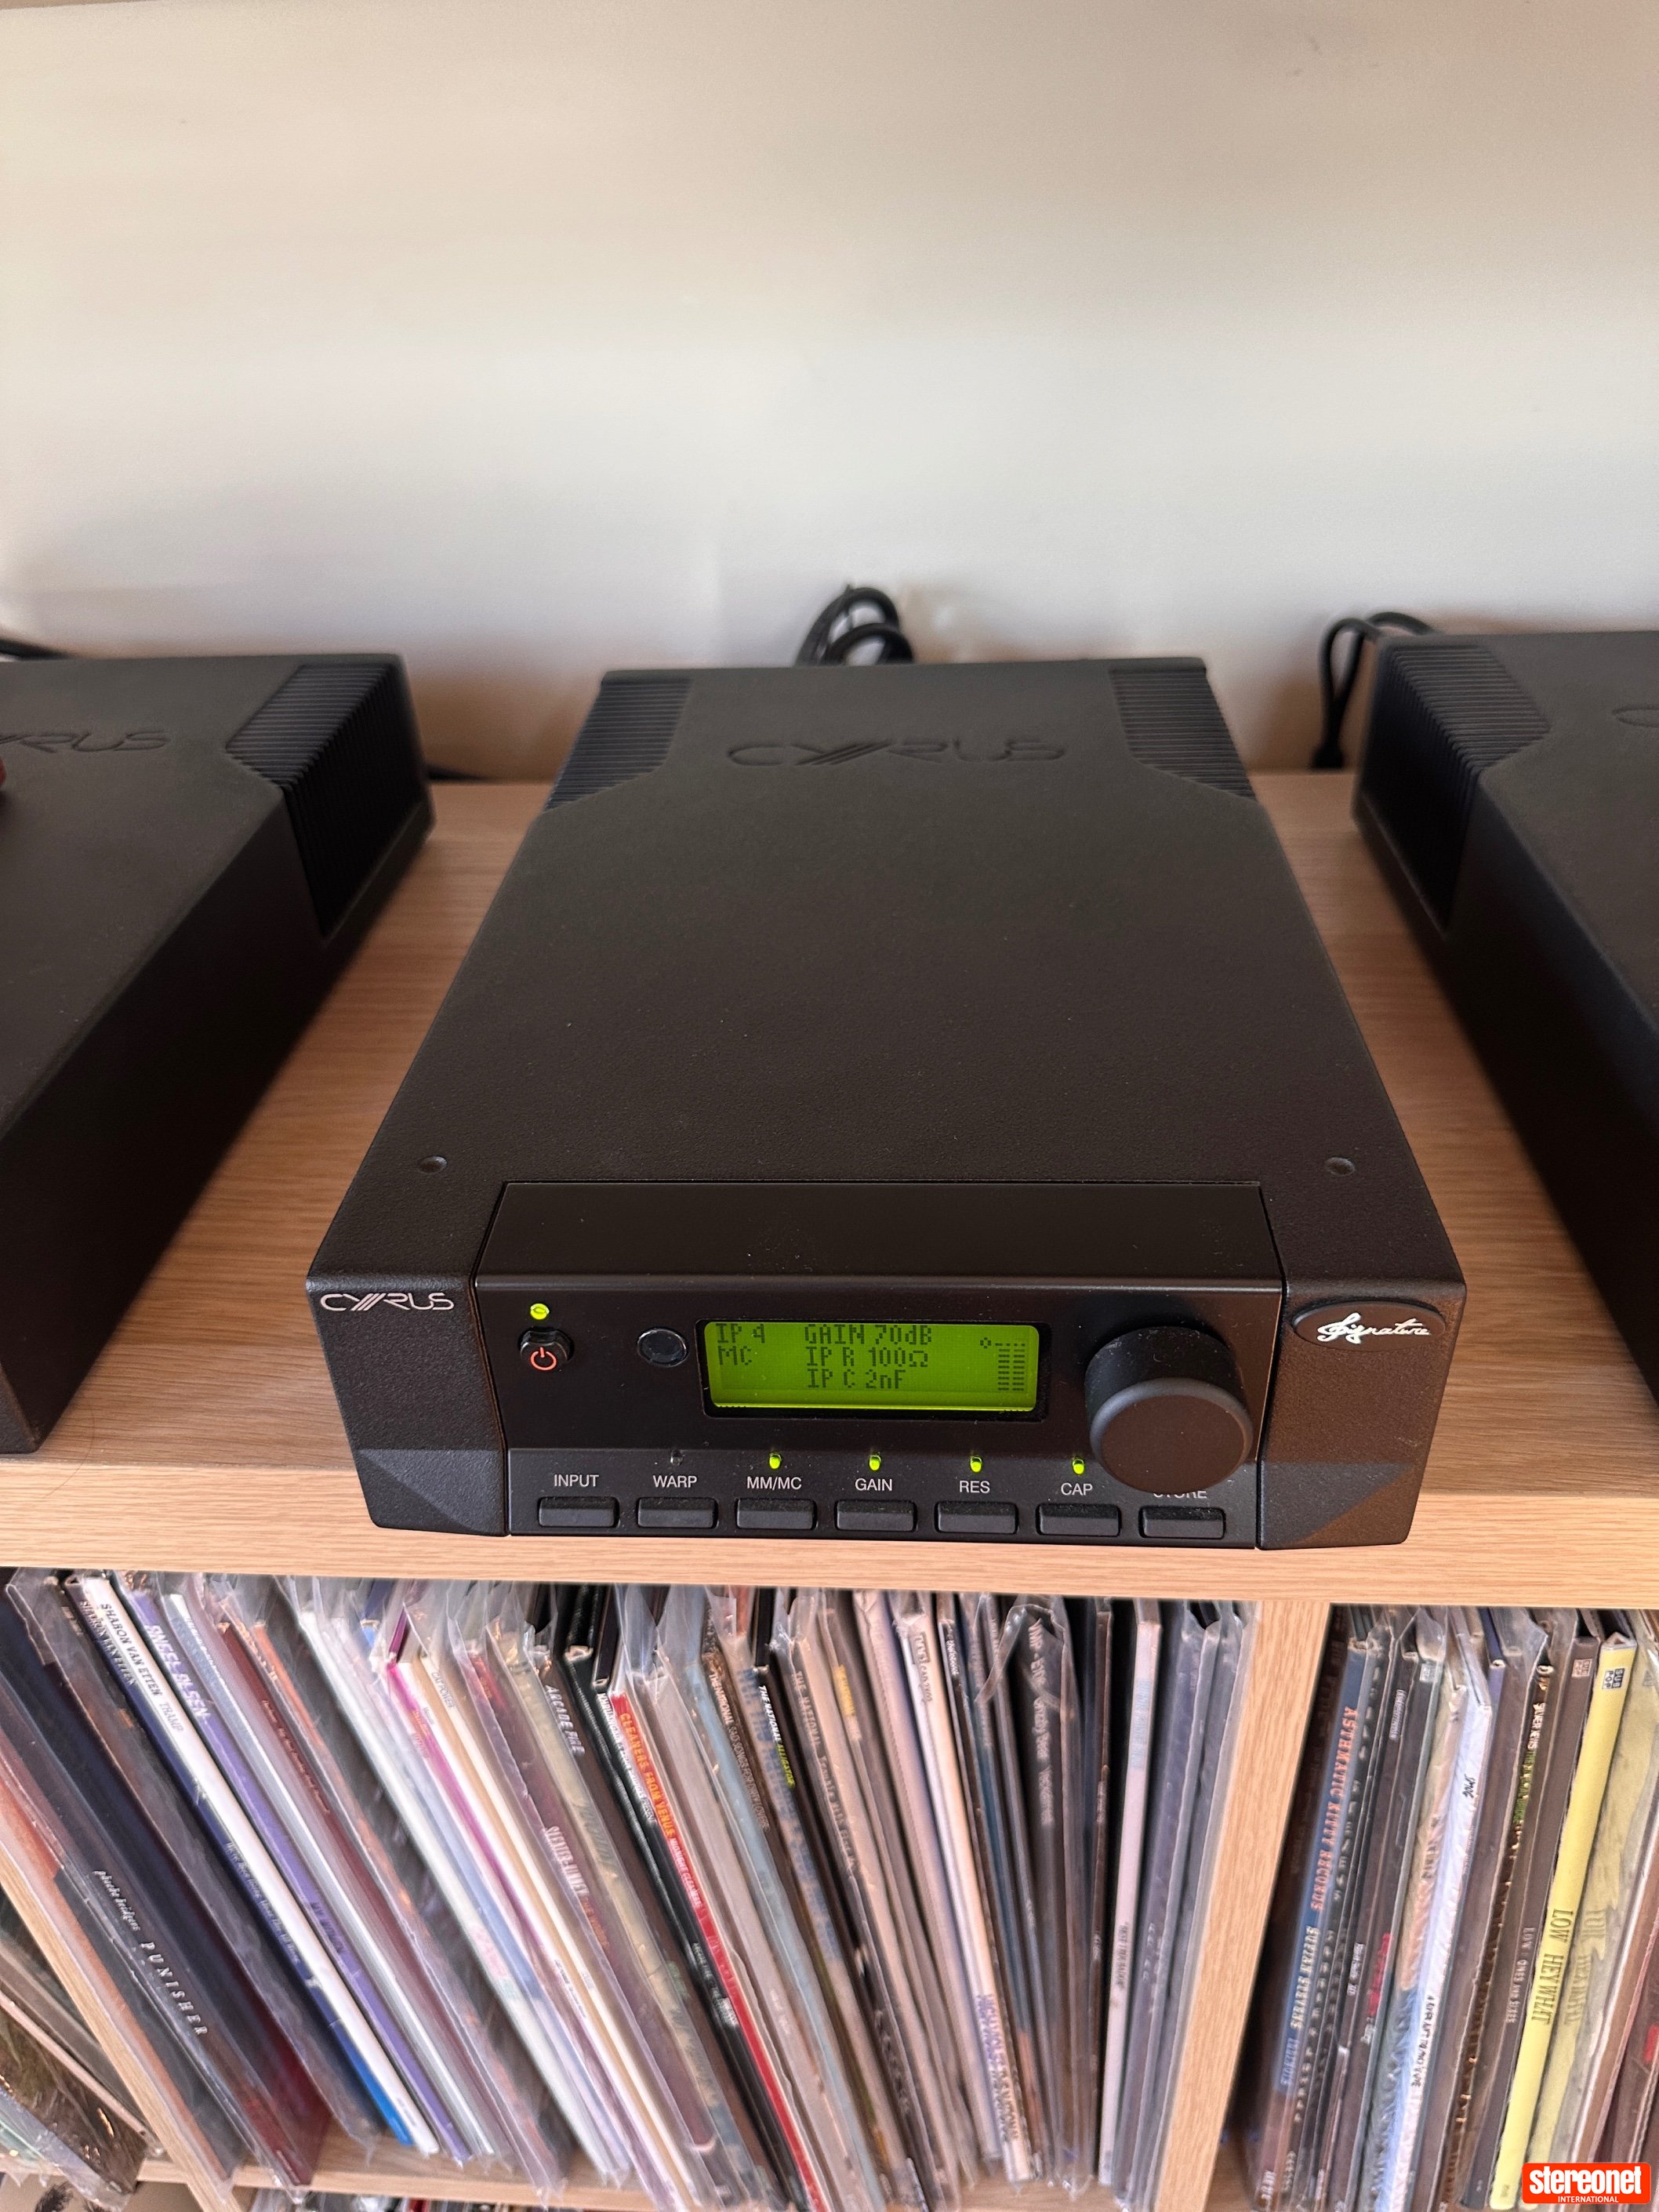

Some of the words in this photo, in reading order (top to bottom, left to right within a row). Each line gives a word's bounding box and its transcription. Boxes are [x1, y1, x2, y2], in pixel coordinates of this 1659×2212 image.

[727, 738, 1066, 767] CYRUS
[320, 1293, 455, 1311] CYRUS
[715, 1323, 742, 1344] IP
[752, 1323, 765, 1344] 4
[804, 1324, 865, 1344] GAIN
[875, 1325, 932, 1345] 70dB
[1317, 1312, 1431, 1344] Signature
[718, 1346, 753, 1365] MC
[806, 1346, 833, 1366] IP
[842, 1347, 855, 1366] R
[868, 1347, 929, 1368] 100Ω
[807, 1369, 833, 1389] IP
[843, 1369, 855, 1389] C
[865, 1369, 906, 1389] 2nF
[554, 1474, 600, 1487] INPUT
[653, 1475, 698, 1488] WARP
[746, 1476, 802, 1489] MM/MC
[855, 1478, 893, 1491] GAIN
[959, 1480, 990, 1493] RES
[1060, 1482, 1093, 1496] CAP
[101, 1604, 132, 1644] SHARON
[126, 1645, 144, 1670] VAN
[139, 1666, 163, 1695] ETTEN
[1028, 1618, 1044, 1650] VMP
[145, 1625, 182, 1666] ANGEL
[172, 1673, 211, 1717] OLSEN
[1604, 1670, 1615, 1688] POP
[1613, 1668, 1625, 1688] SUB
[759, 1684, 770, 1704] THE
[545, 1685, 574, 1731] ARCADE
[564, 1730, 585, 1757] FIRE
[764, 1702, 783, 1744] NATIONAL
[776, 1743, 796, 1789] ALLIGATOR
[1330, 1706, 1358, 1798] ASTHMATIC
[619, 1712, 649, 1771] CLEANERS
[644, 1771, 663, 1802] FROM
[656, 1800, 676, 1839] VENUS
[1321, 1800, 1341, 1847] KITTY
[1310, 1848, 1332, 1912] RECORDS
[1548, 1909, 1574, 1943] LOW
[1539, 1953, 1564, 1984] HEY
[140, 1942, 208, 2035] PUNISHER
[1290, 1974, 1311, 2030] STEVENS
[1530, 1984, 1557, 2025] WHAT
